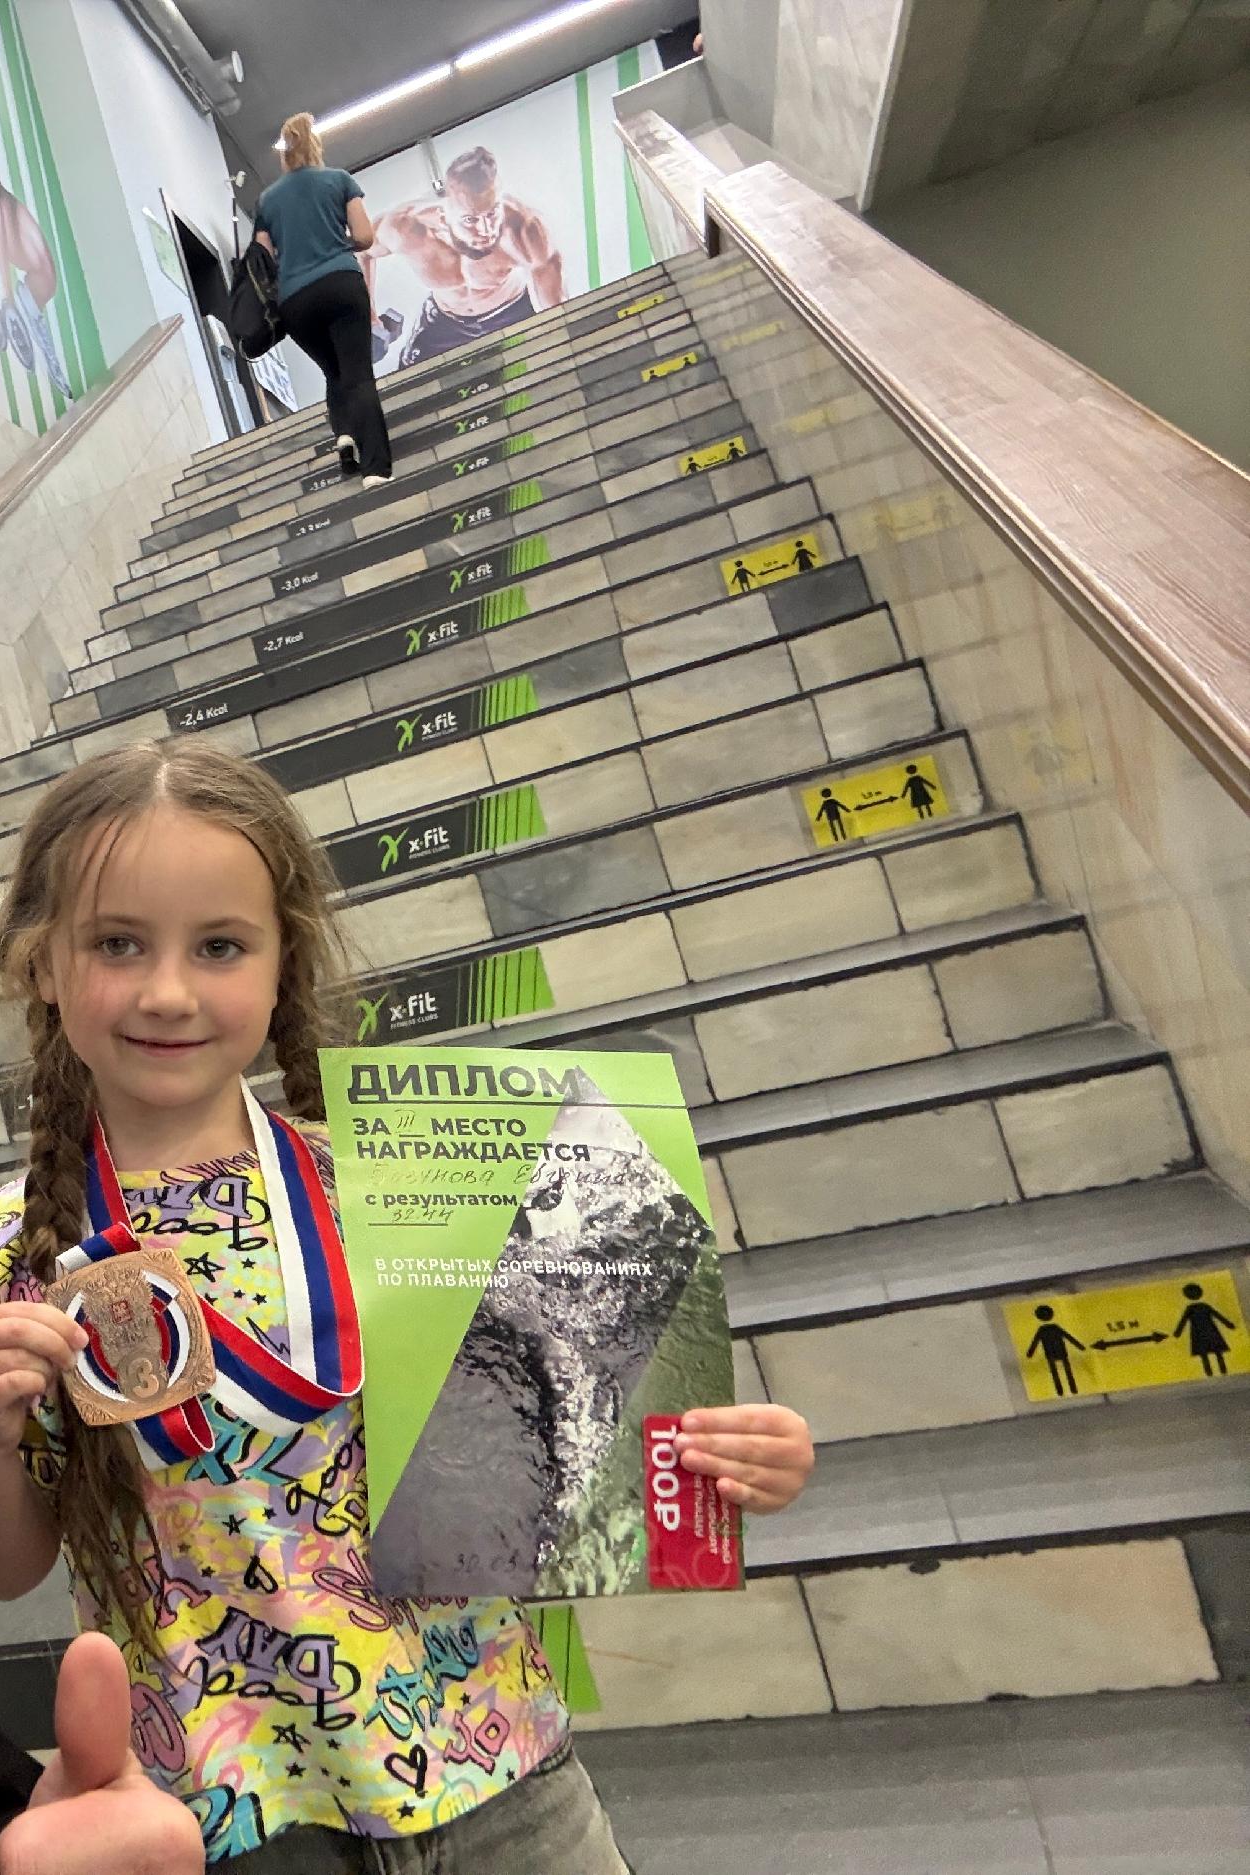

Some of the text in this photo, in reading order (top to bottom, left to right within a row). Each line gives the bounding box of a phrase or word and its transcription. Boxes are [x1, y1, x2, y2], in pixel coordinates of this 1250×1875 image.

[347, 1064, 582, 1103] ДИПЛОМ
[352, 1118, 391, 1137] ЗА
[432, 1118, 528, 1138] МЕСТО
[357, 1140, 591, 1164] НАГРАЖДАЕТСЯ
[383, 1191, 519, 1214] результатом
[375, 1258, 653, 1277] В ОТКРЫТЫХ СОРЕВНОВАНИЯХ
[378, 1273, 510, 1289] ПО ПЛАВАНИЮ
